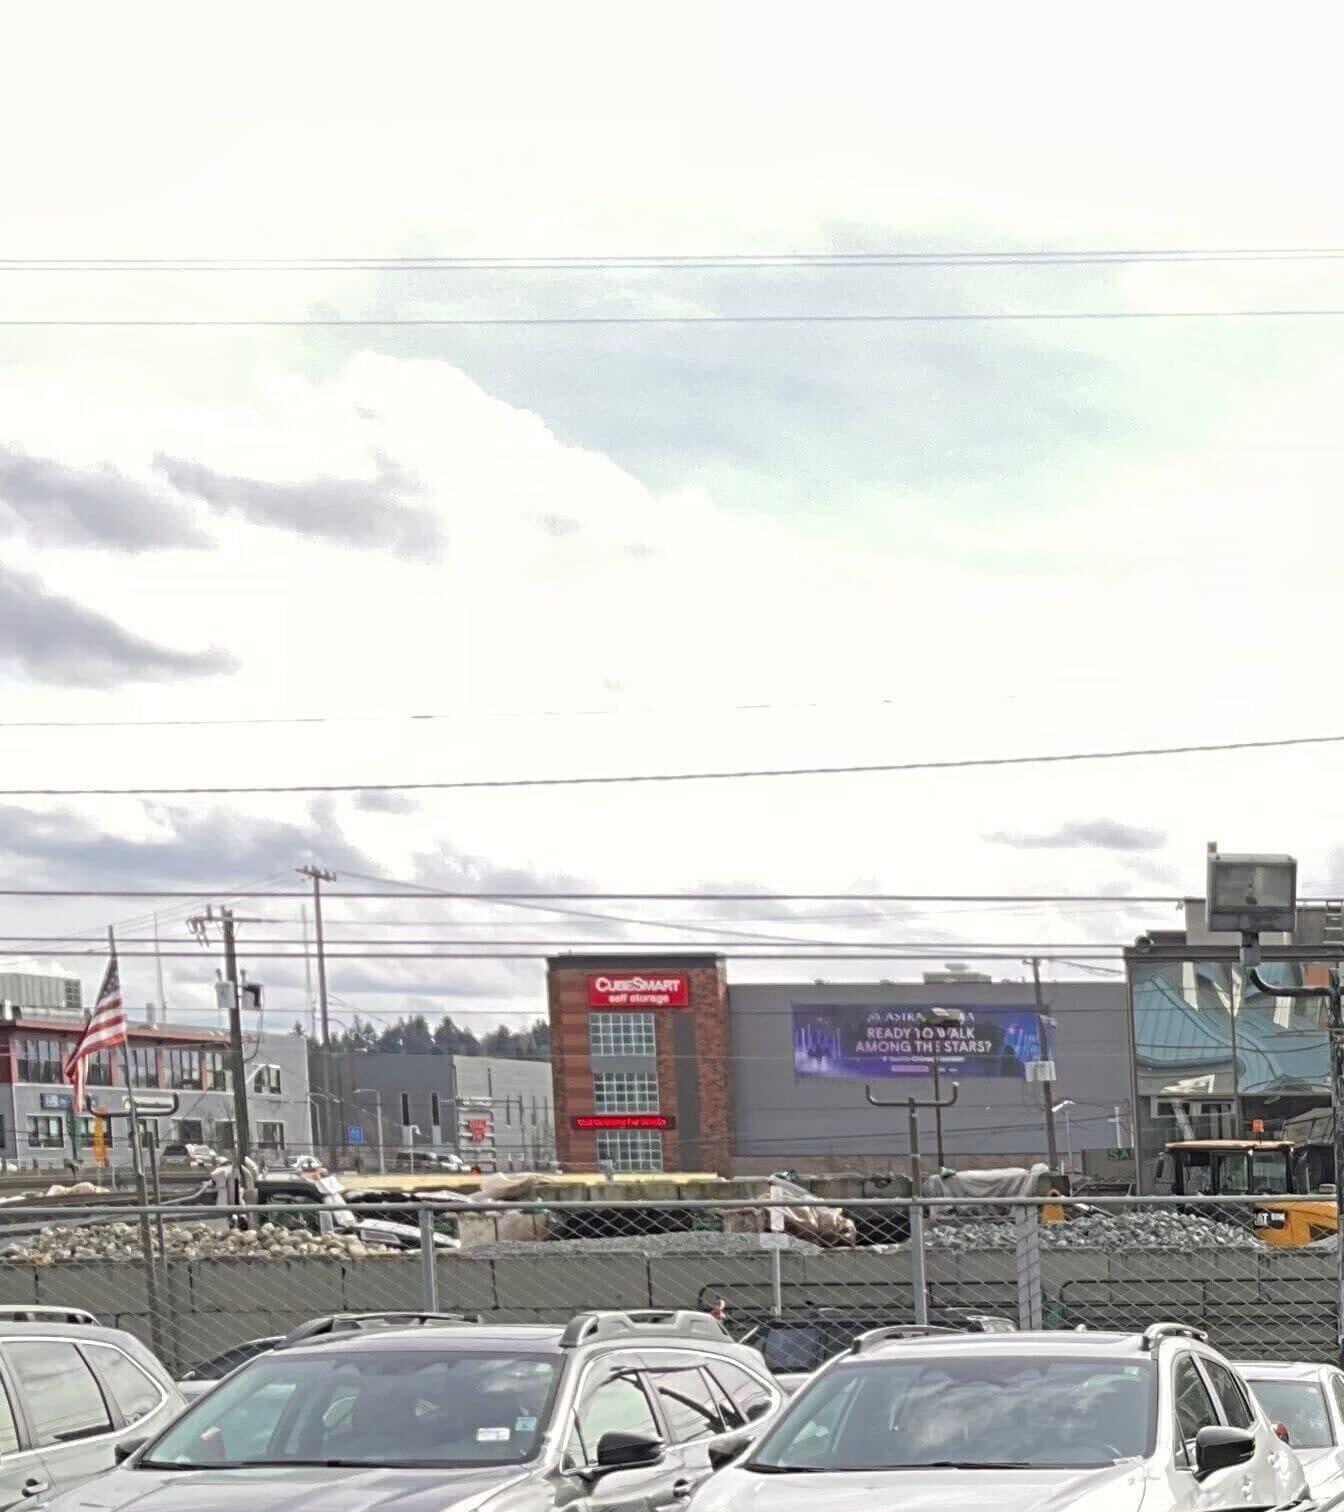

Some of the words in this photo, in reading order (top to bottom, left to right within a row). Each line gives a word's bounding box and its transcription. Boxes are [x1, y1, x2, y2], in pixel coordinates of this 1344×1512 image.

[867, 1027, 911, 1039] READY
[855, 1040, 911, 1052] AMONG
[914, 1040, 942, 1053] THE
[944, 1040, 992, 1053] STARS?
